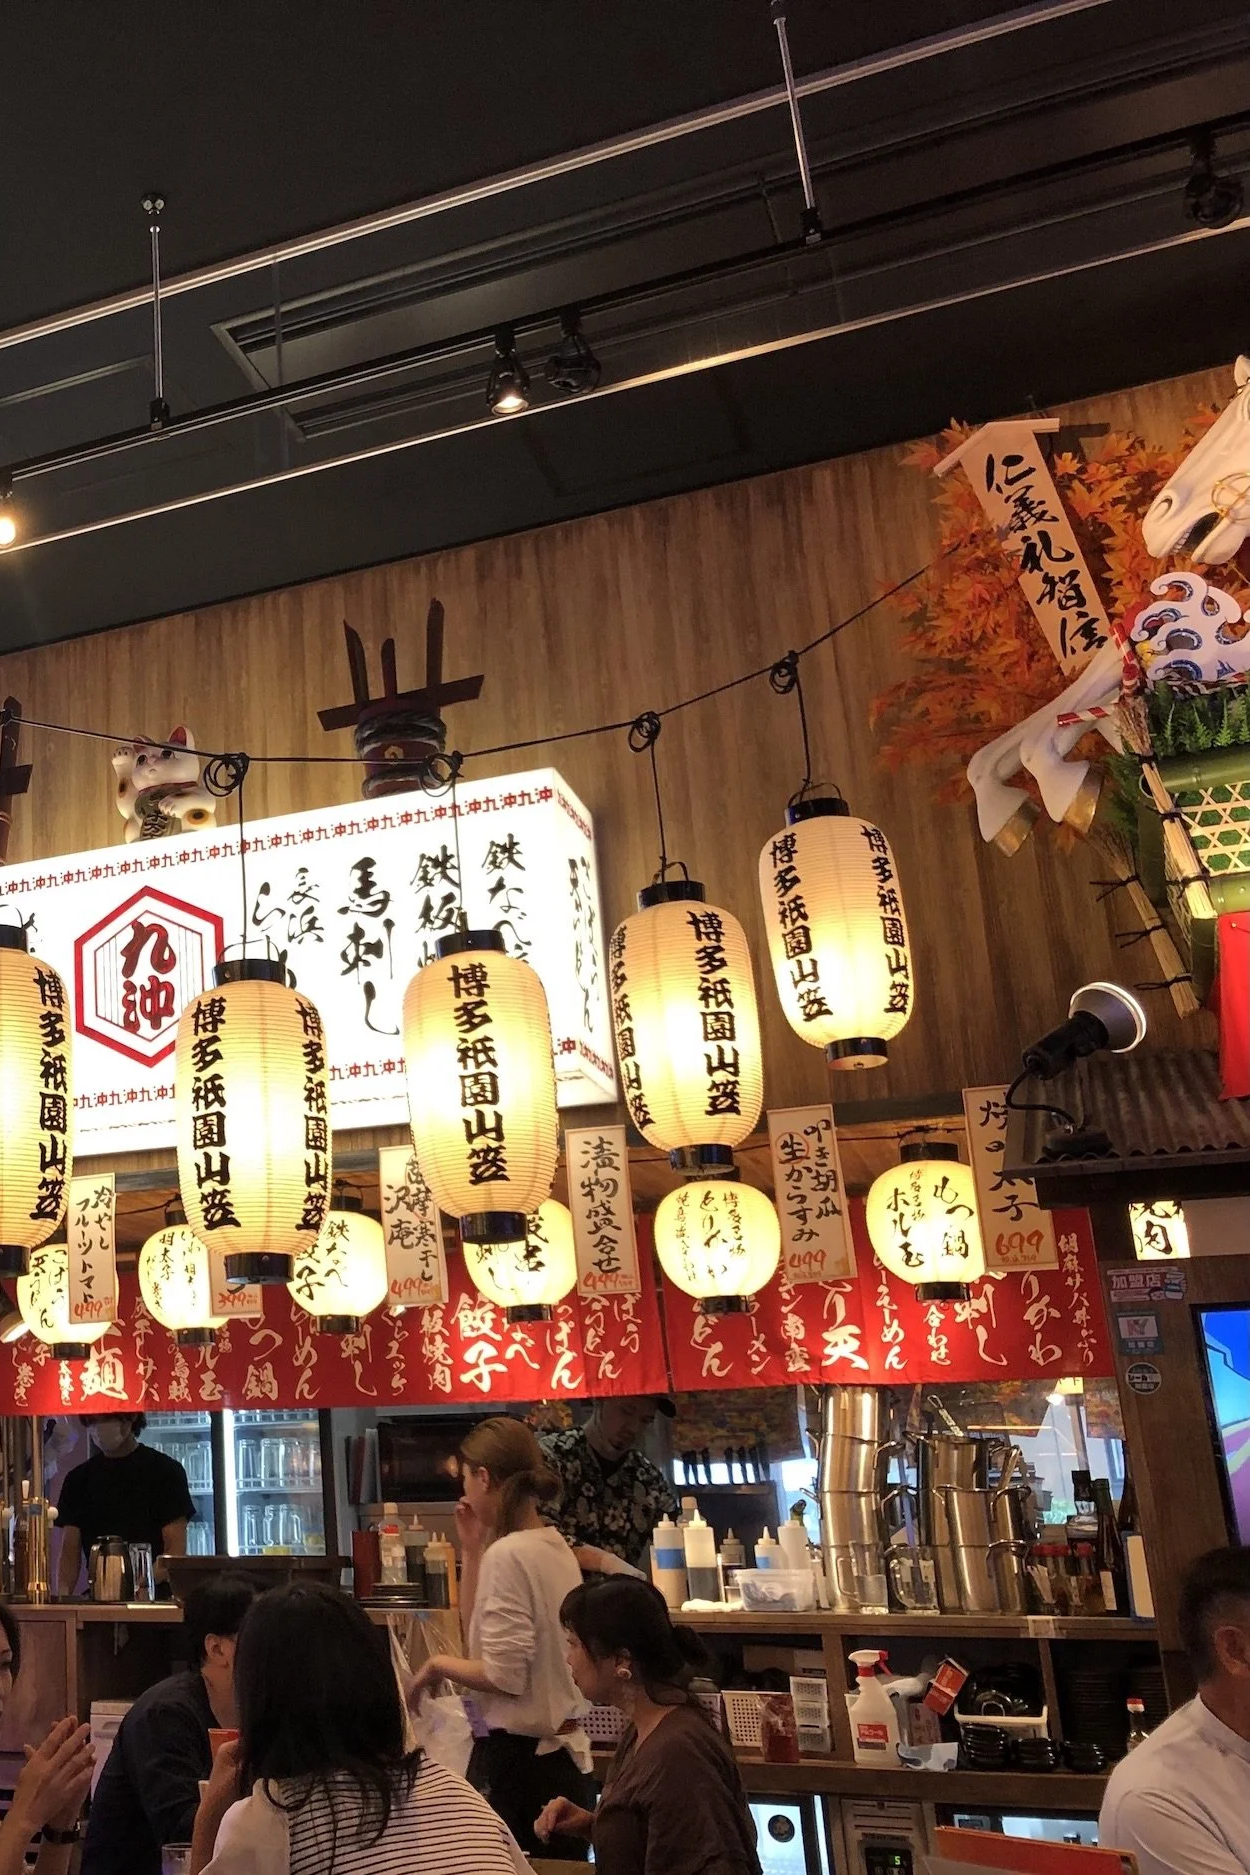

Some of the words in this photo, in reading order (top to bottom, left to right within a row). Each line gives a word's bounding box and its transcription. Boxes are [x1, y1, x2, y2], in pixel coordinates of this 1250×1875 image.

[337, 856, 400, 1036] 馬刺し
[768, 831, 834, 1023] 博多祇園山笠
[860, 823, 911, 1016] 博多祇園山笠
[120, 920, 176, 1033] 九沖
[686, 910, 743, 1117] 博多祇園山笠
[190, 996, 241, 1231] 博多祇園山笠
[447, 962, 512, 1187] 博多祇園山笠
[390, 1277, 422, 1299] 499
[789, 1249, 826, 1272] 499
[995, 1229, 1044, 1256] 699
[74, 1300, 103, 1320] 499
[217, 1292, 247, 1309] 399
[419, 1302, 454, 1394] 板焼肉
[1021, 1271, 1063, 1367] りかわ
[340, 1318, 378, 1397] 刺し
